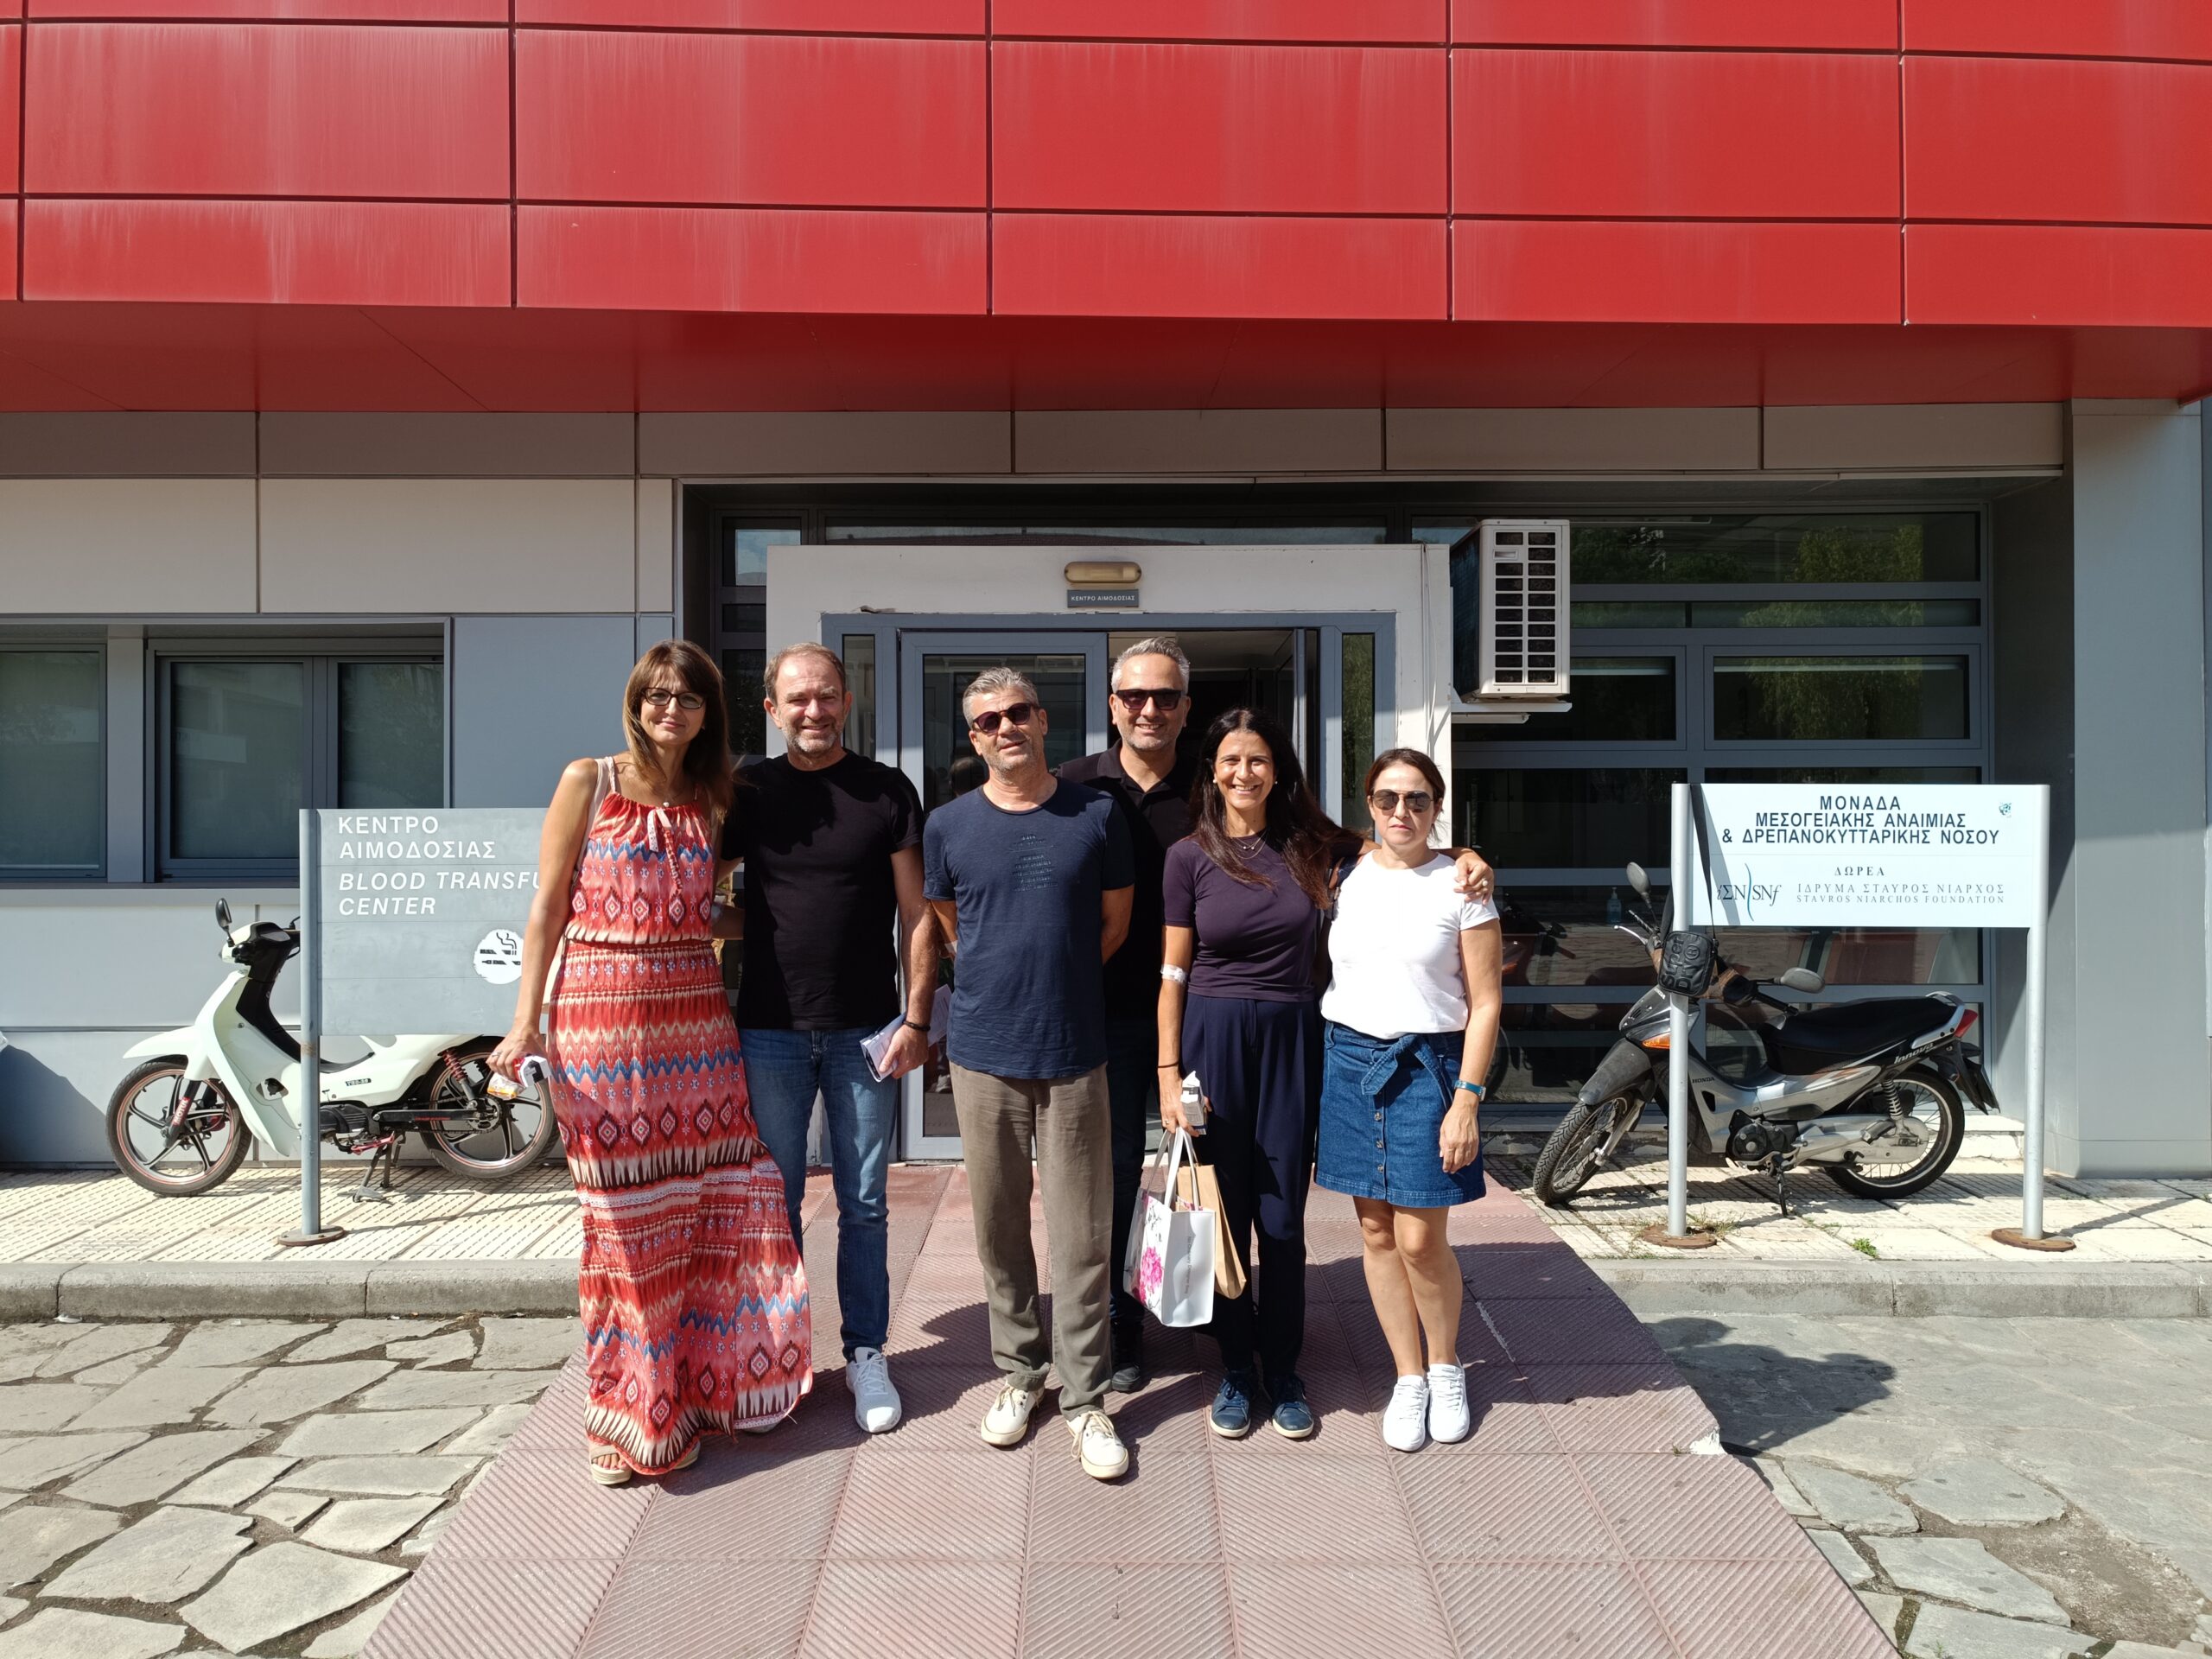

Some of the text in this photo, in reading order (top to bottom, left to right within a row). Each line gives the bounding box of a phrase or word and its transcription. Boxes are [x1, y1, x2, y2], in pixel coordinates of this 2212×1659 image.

[1820, 795, 1901, 810] ΜΟΝΑΔΑ
[338, 816, 439, 835] ΚΕΝΤΡΟ
[1756, 812, 1966, 828] ΜΕΣΟΓΕΙΑΚΗΣ ΑΝΑΙΜΙΑΣ
[1722, 828, 1999, 844] & ΔΡΕΠΑΝΟΚΥΤΤΑΡΙΚΗΣ ΝΟΣΟΥ
[339, 841, 496, 859] ΑΙΜΟΔΟΣΙΑΣ
[1834, 866, 1885, 876] ΔΩΡΕΑ
[339, 872, 426, 891] BLOOD
[1797, 883, 2004, 893] ΙΔΡΥΜΑ ΣΤΑΥΡΟΣ ΝΙΑΡΧΟΣ
[339, 898, 435, 916] CENTER
[1857, 895, 1919, 904] NIARCHOS
[1925, 895, 2005, 904] FOUNDATION
[1894, 1042, 1934, 1065] Innova
